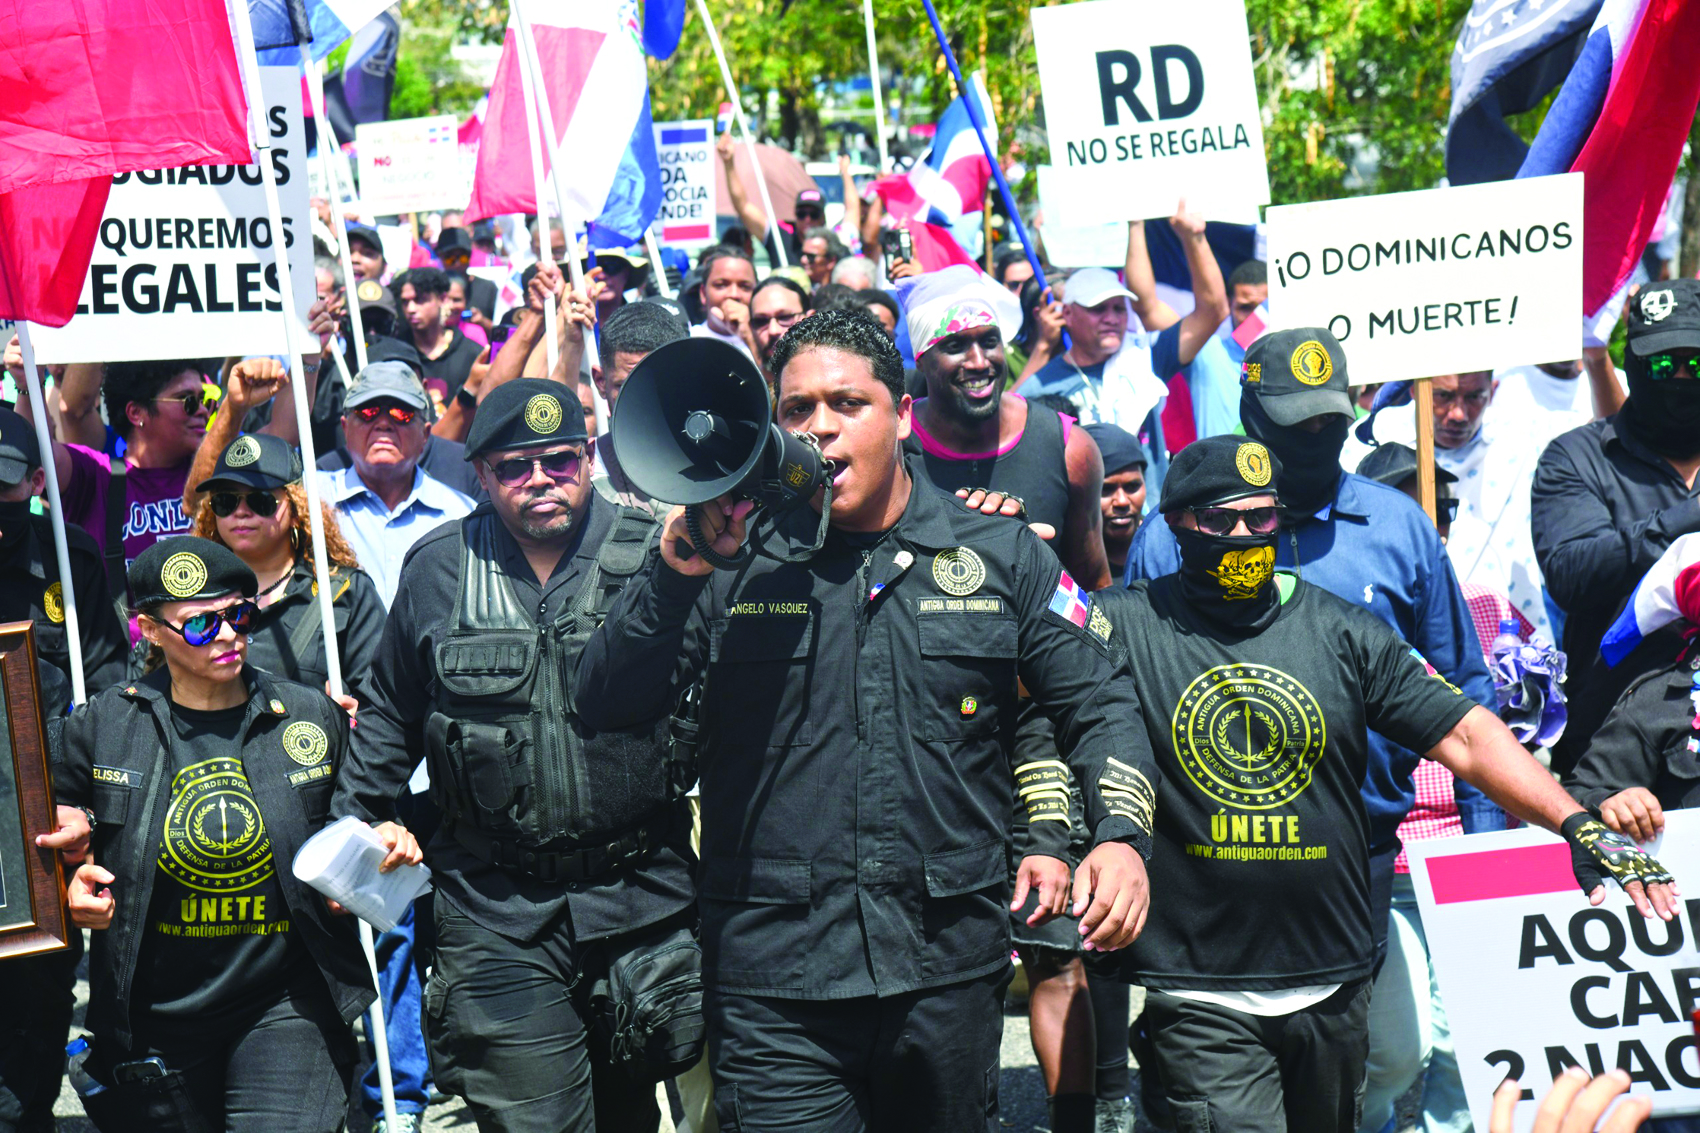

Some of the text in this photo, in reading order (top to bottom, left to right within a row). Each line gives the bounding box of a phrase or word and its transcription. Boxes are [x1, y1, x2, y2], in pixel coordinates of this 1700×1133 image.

[1095, 44, 1205, 126] RD
[1067, 123, 1250, 166] NO SE REGALA
[100, 216, 294, 257] QUEREMOS
[1275, 221, 1573, 288] ¡O DOMINICANOS
[1328, 295, 1518, 342] O MUERTE!
[122, 496, 191, 541] OND
[731, 603, 808, 615] ANGELO VASQUEZ
[920, 600, 1000, 611] ANTIGUA ORDEN DOMINICANA
[1196, 685, 1300, 735] ANTIGUA ORDEN DOMINICANA
[1286, 740, 1306, 748] Patria
[1201, 747, 1296, 784] DEFENSA DE LA PATRIA
[174, 789, 197, 824] ANTIGUA
[198, 778, 228, 792] ORDEN
[1211, 808, 1300, 843] ÚNETE
[176, 839, 209, 868] DEFENSA
[214, 862, 226, 870] DE
[231, 860, 243, 868] LA
[1185, 843, 1327, 862] www.antiguaorden.com
[180, 893, 266, 922] ÚNETE
[157, 919, 290, 938] ww.antiguaorden.cm
[1483, 1049, 1535, 1101] 2
